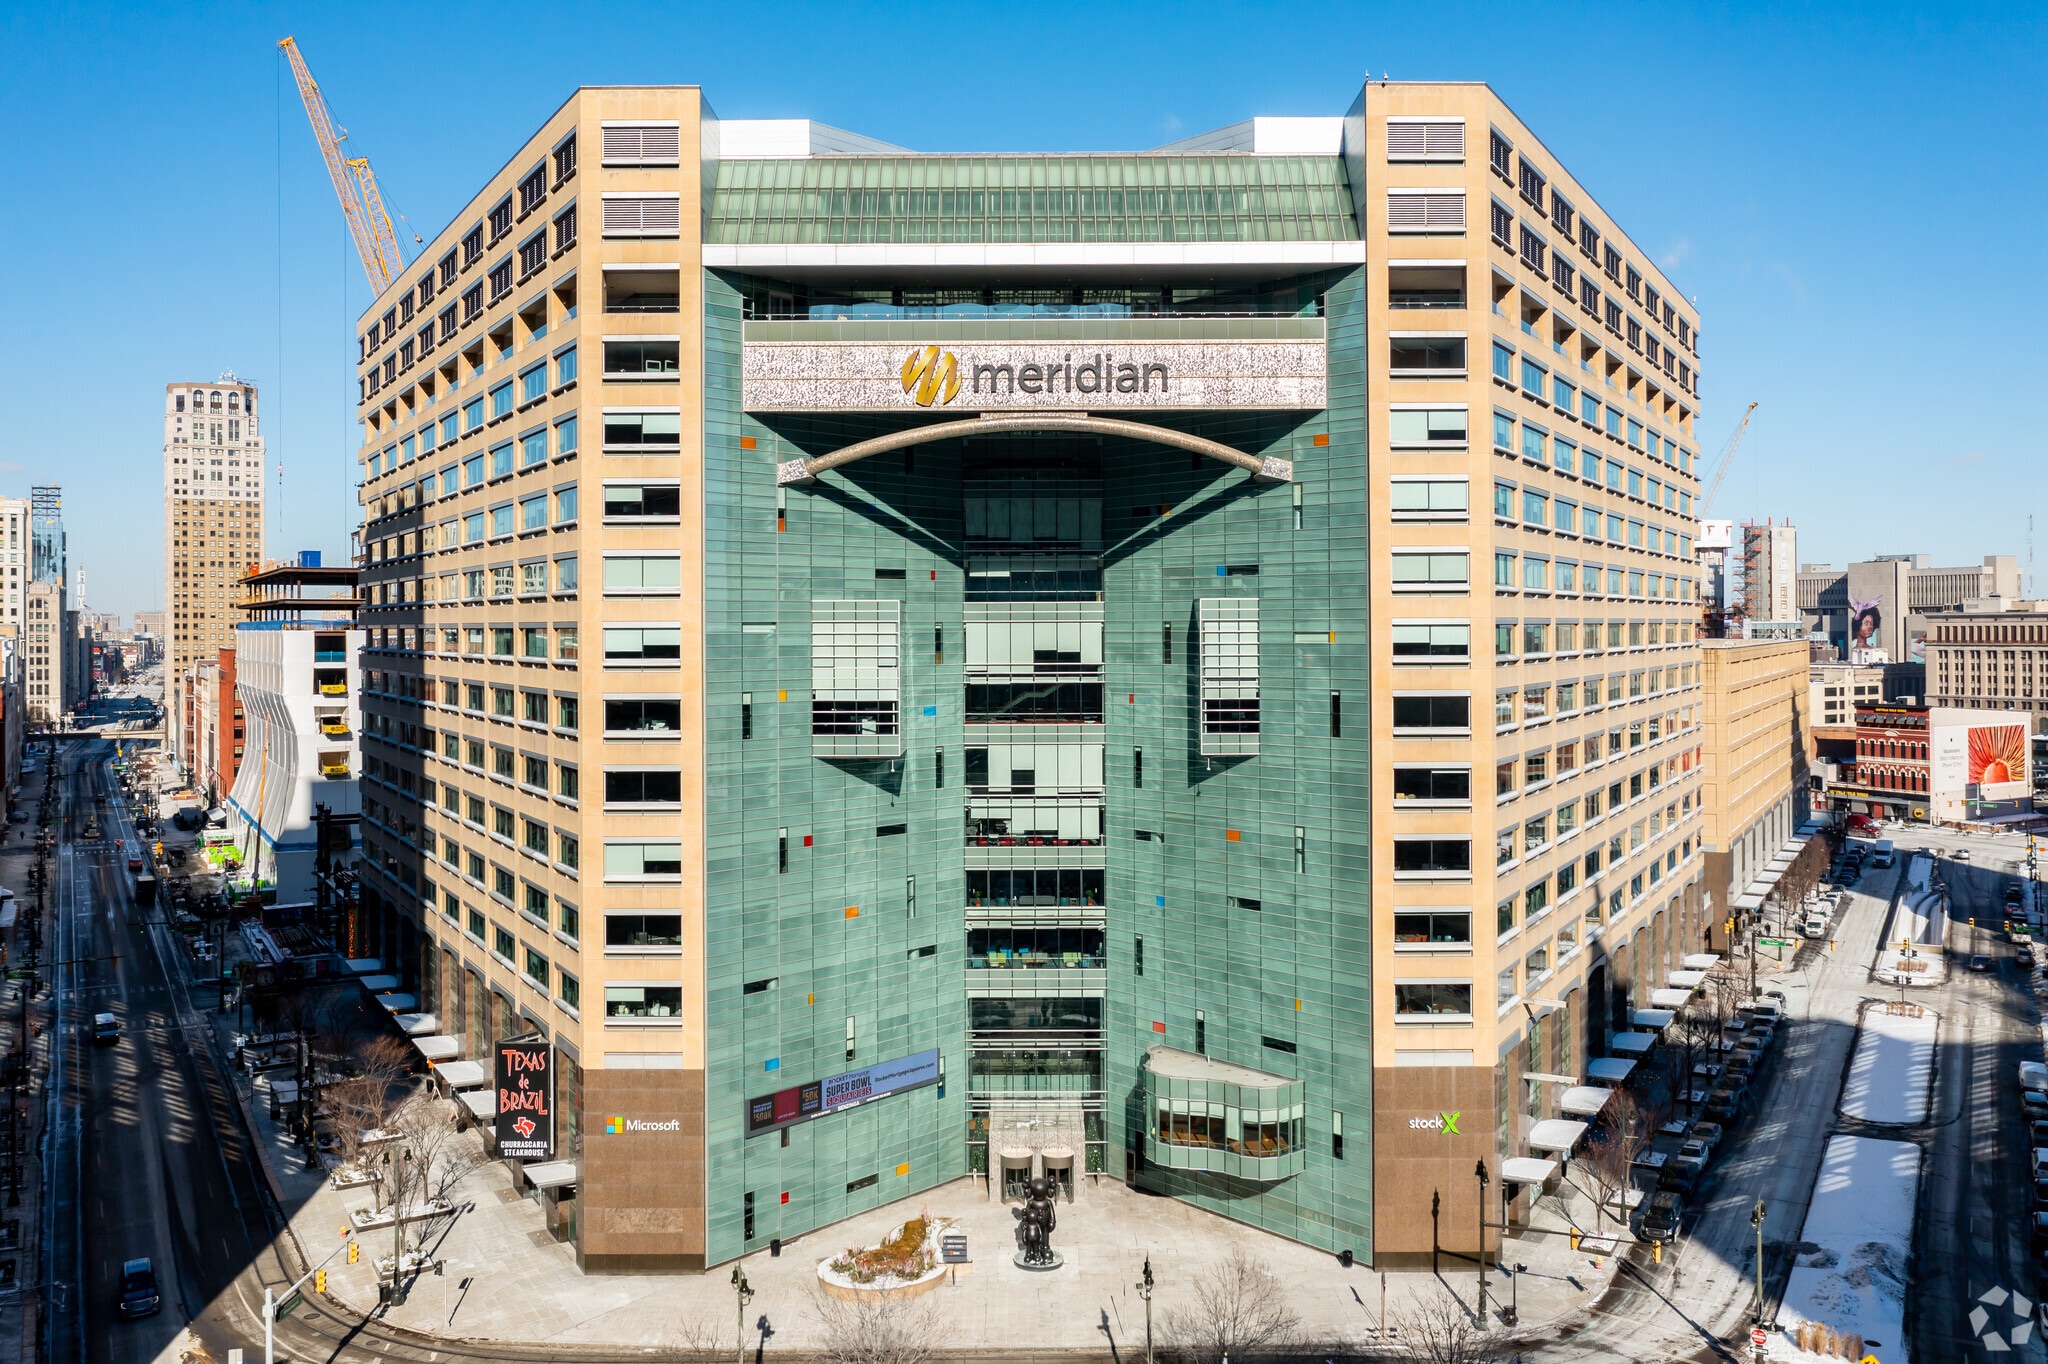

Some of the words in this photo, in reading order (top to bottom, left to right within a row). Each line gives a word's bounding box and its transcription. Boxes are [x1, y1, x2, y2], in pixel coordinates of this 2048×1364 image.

[973, 354, 1168, 393] meridian
[502, 1050, 546, 1077] TEXAS
[518, 1074, 530, 1089] de
[826, 1082, 849, 1097] SUPER
[851, 1076, 872, 1091] BOWL
[827, 1086, 872, 1105] SQUARES
[626, 1119, 680, 1131] Microsoft
[1409, 1110, 1460, 1135] stockX
